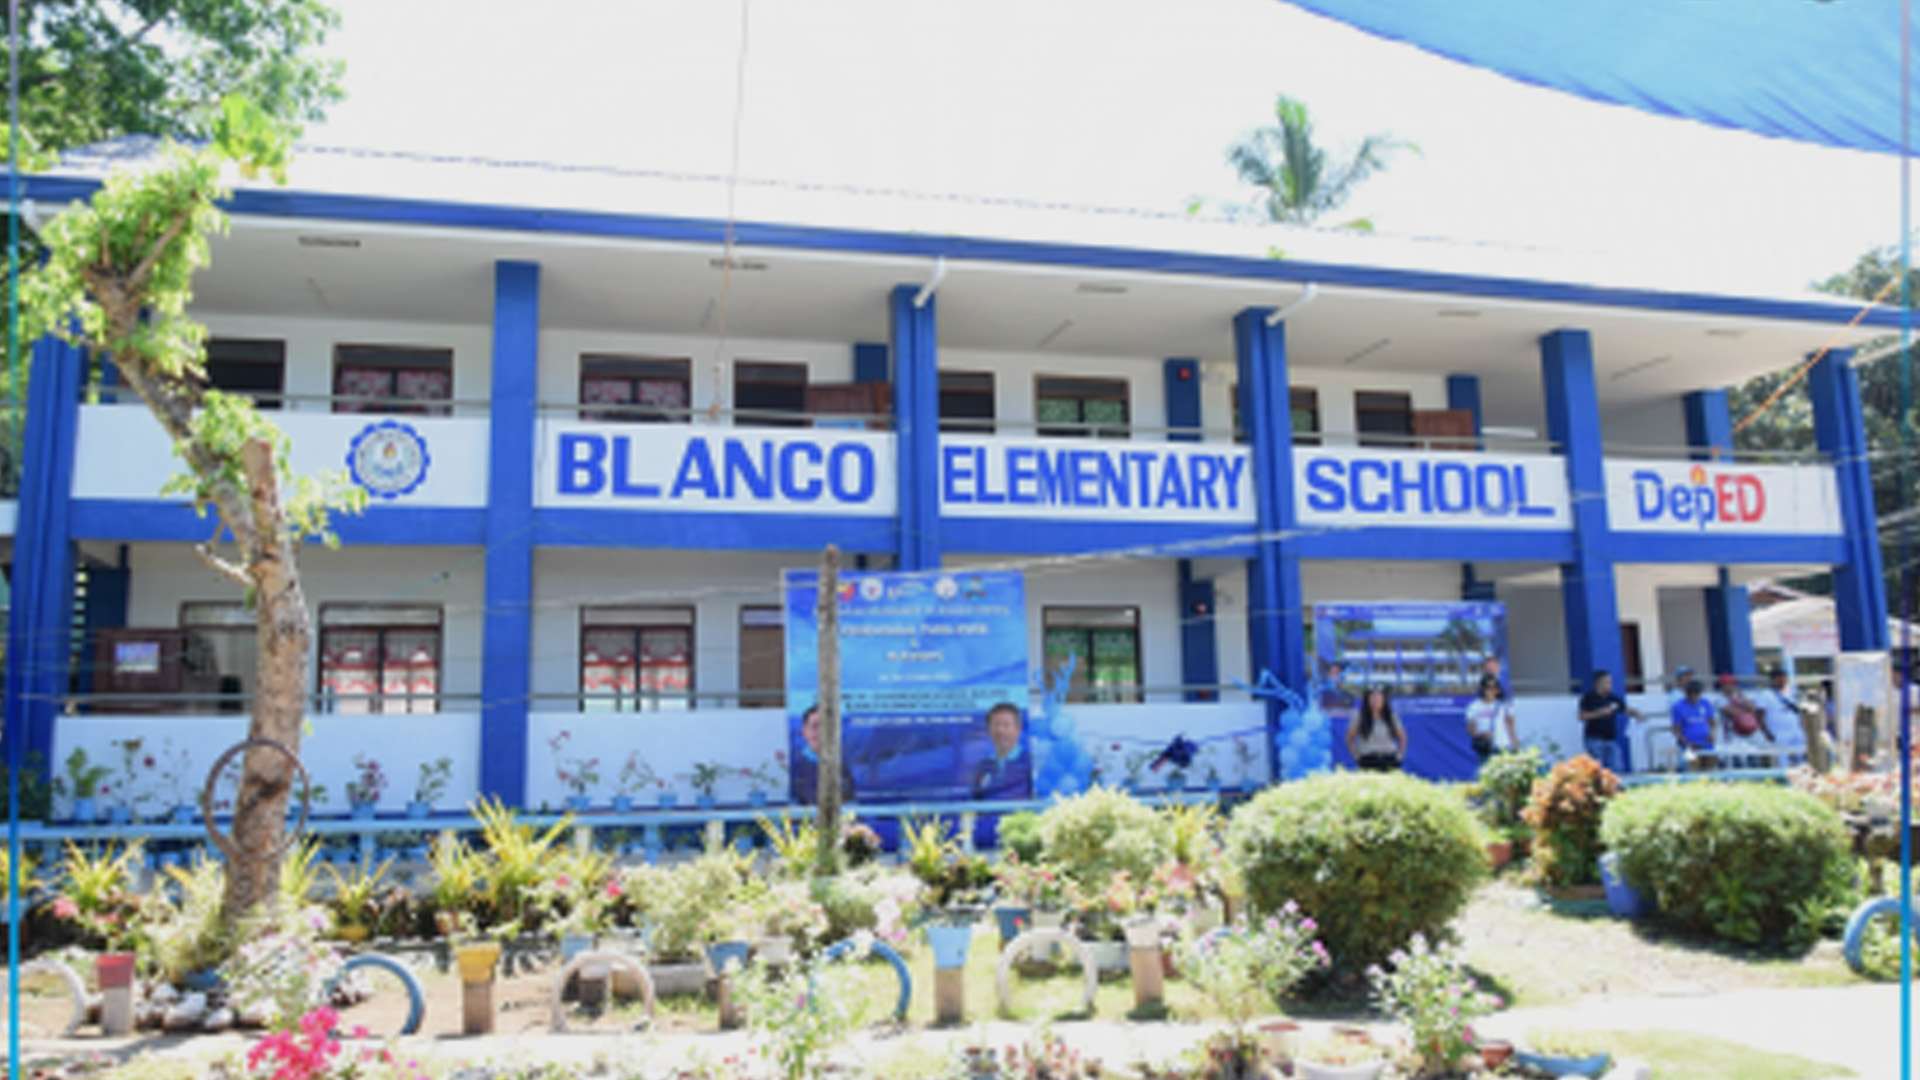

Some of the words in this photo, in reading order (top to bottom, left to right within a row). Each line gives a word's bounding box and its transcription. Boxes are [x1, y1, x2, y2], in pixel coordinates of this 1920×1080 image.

[556, 433, 876, 504] BLANCO
[942, 446, 1246, 510] ELEMENTARY
[1305, 457, 1556, 517] SCHOOL
[1632, 468, 1767, 531] DepED
